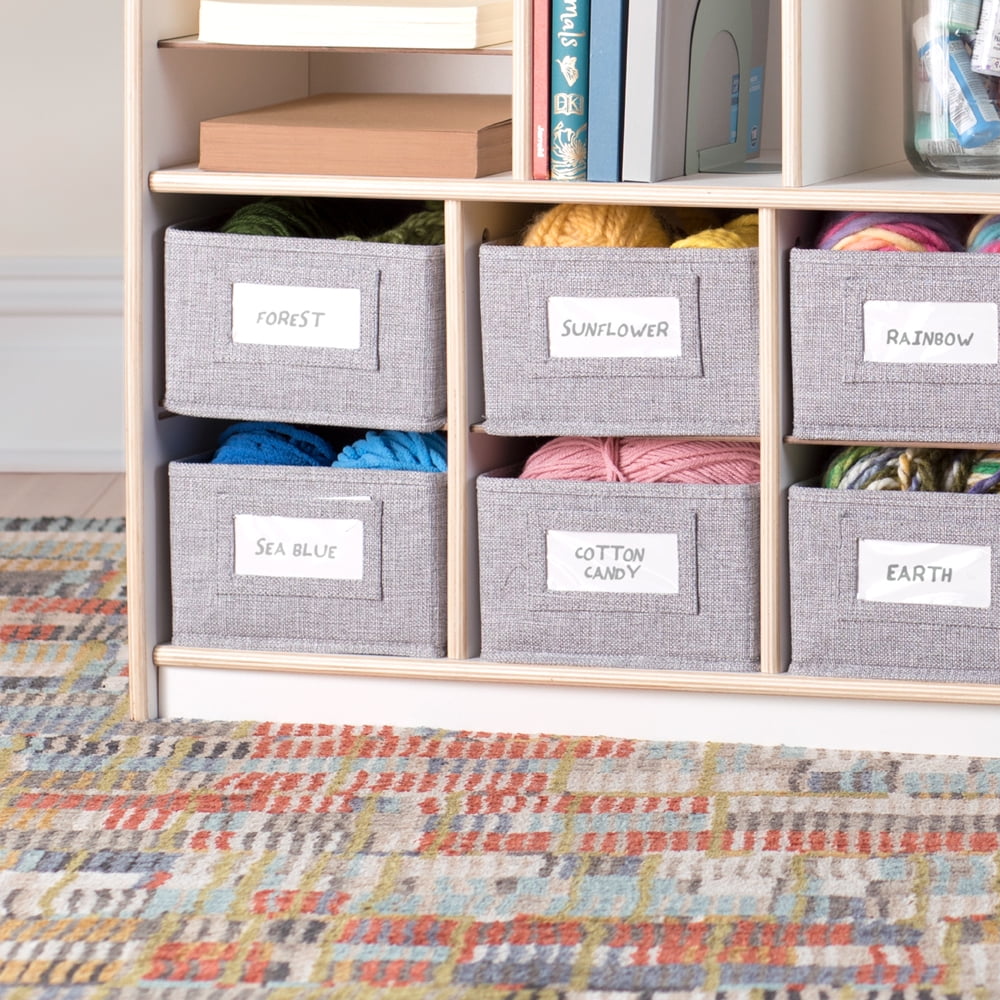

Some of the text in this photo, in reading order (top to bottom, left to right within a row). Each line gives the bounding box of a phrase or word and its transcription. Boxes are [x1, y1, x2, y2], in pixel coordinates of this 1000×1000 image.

[256, 310, 326, 328] FOREST
[560, 318, 670, 338] SUNFLOWER
[886, 328, 975, 347] RAINBOW
[254, 537, 338, 560] SEA BLUE
[574, 544, 646, 562] COTTON
[583, 564, 642, 581] CANDY
[886, 563, 953, 583] EARTH
